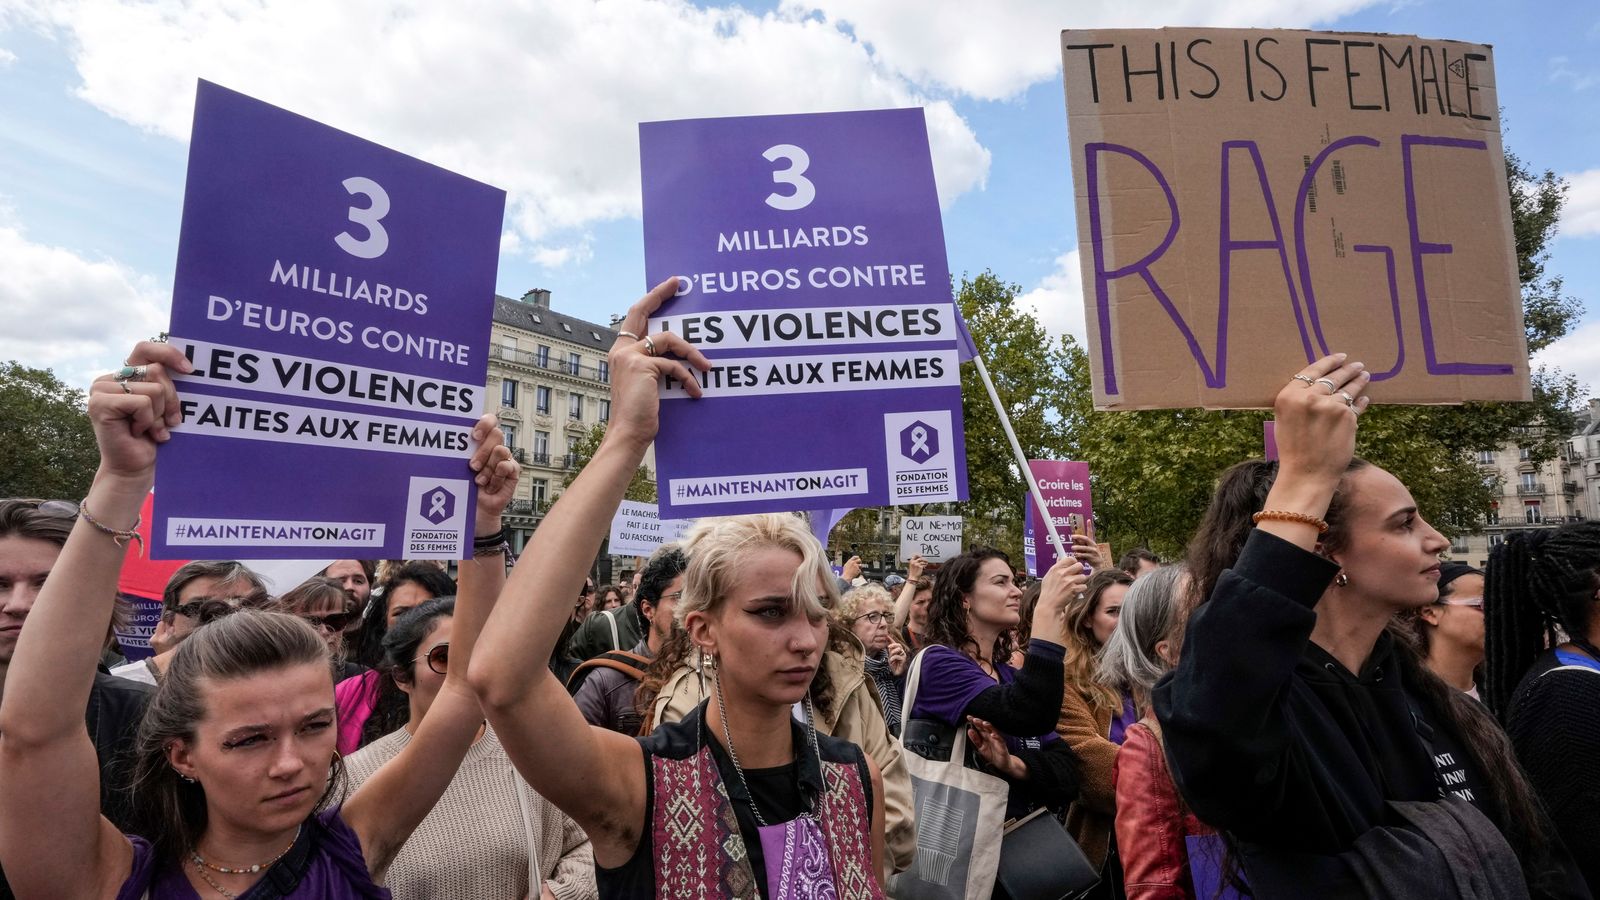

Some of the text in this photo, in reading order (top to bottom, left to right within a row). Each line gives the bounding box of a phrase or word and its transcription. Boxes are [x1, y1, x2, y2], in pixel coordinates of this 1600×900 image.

[1066, 37, 1492, 121] THIS IS FEMALE
[762, 144, 816, 211] 3
[334, 176, 391, 259] 3
[717, 225, 869, 253] MILLIARDS
[1084, 133, 1514, 395] RAGE
[269, 259, 428, 316] MILLIARDS
[674, 264, 926, 297] D'EUROS CONTRE
[206, 295, 470, 366] D'EUROS CONTRE
[732, 308, 942, 342] VIOLENCES
[186, 344, 473, 413] LES VIOLENCES
[765, 362, 823, 386] AUX
[832, 357, 944, 383] FEMMES
[182, 400, 469, 452] FAITES AUX FEMMES
[676, 475, 858, 498] #MAINTENANTONAGIT
[896, 471, 948, 482] FONDATION
[1038, 479, 1084, 490] Croire les
[896, 484, 949, 495] DES FEMMES
[1043, 497, 1083, 508] victimes
[175, 525, 376, 542] #MAINTENANTONAGIT
[626, 521, 640, 529] FAIT
[906, 519, 924, 530] QUI
[410, 543, 457, 553] DES FEMMES
[411, 532, 458, 541] FONDATION
[632, 534, 664, 544] FASCISME
[924, 533, 962, 542] CONSENT
[921, 543, 940, 555] PAS
